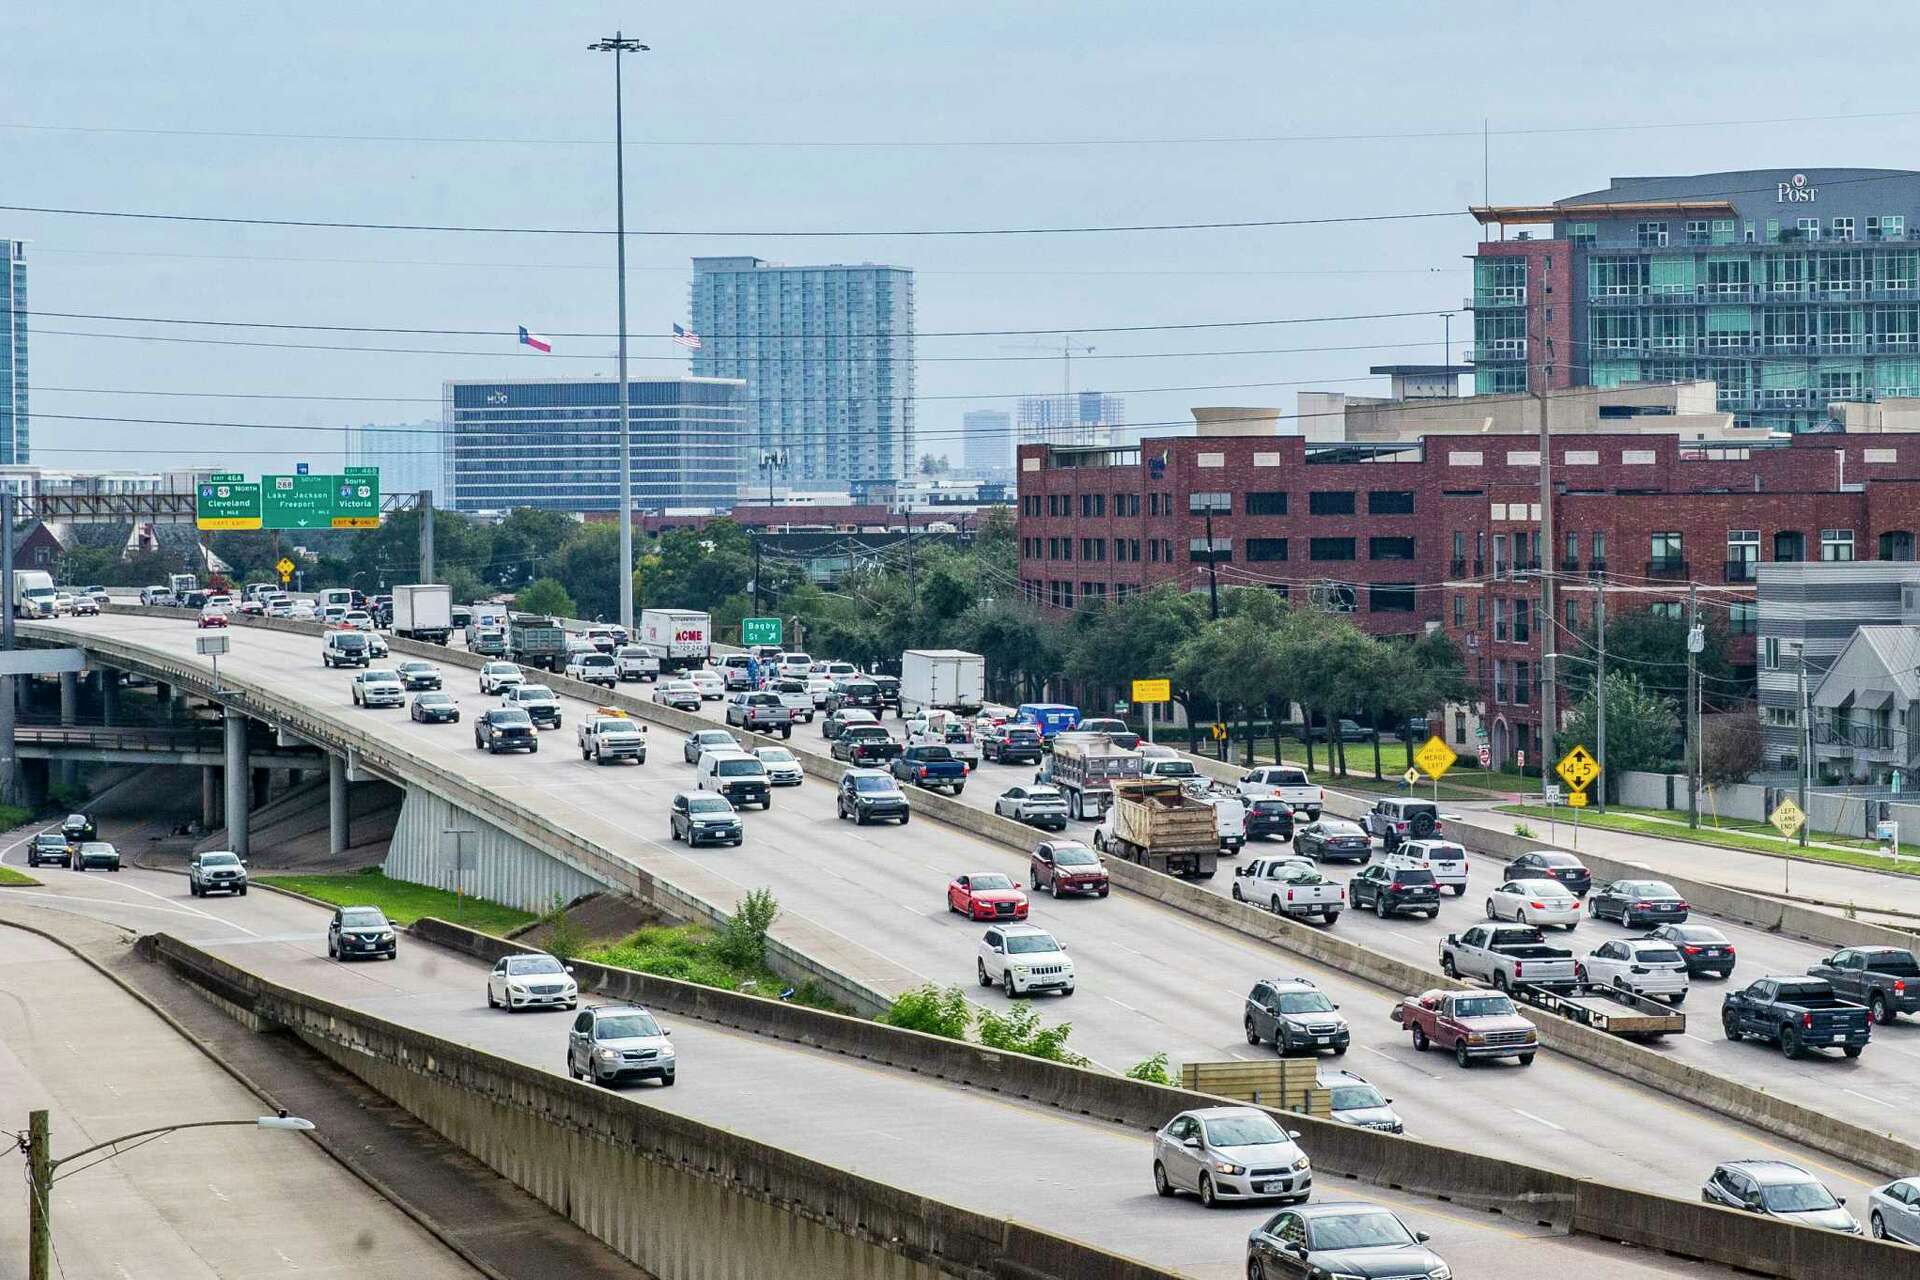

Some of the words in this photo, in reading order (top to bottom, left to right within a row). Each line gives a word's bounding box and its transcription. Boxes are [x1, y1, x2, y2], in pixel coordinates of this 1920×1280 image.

[202, 488, 213, 497] 69
[217, 487, 230, 498] 59
[266, 491, 286, 499] Lake
[293, 491, 328, 499] Jackson
[341, 487, 352, 497] 69
[358, 486, 370, 497] 59
[208, 499, 251, 508] Cleveland
[279, 500, 314, 509] Freeport
[339, 499, 372, 508] Victoria
[748, 622, 777, 631] Bagby
[675, 630, 703, 642] ACME
[748, 632, 759, 641] St
[1424, 753, 1447, 761] MERGE
[1427, 762, 1445, 770] LEFT
[1780, 807, 1795, 815] LEFT
[1779, 814, 1796, 822] LANE
